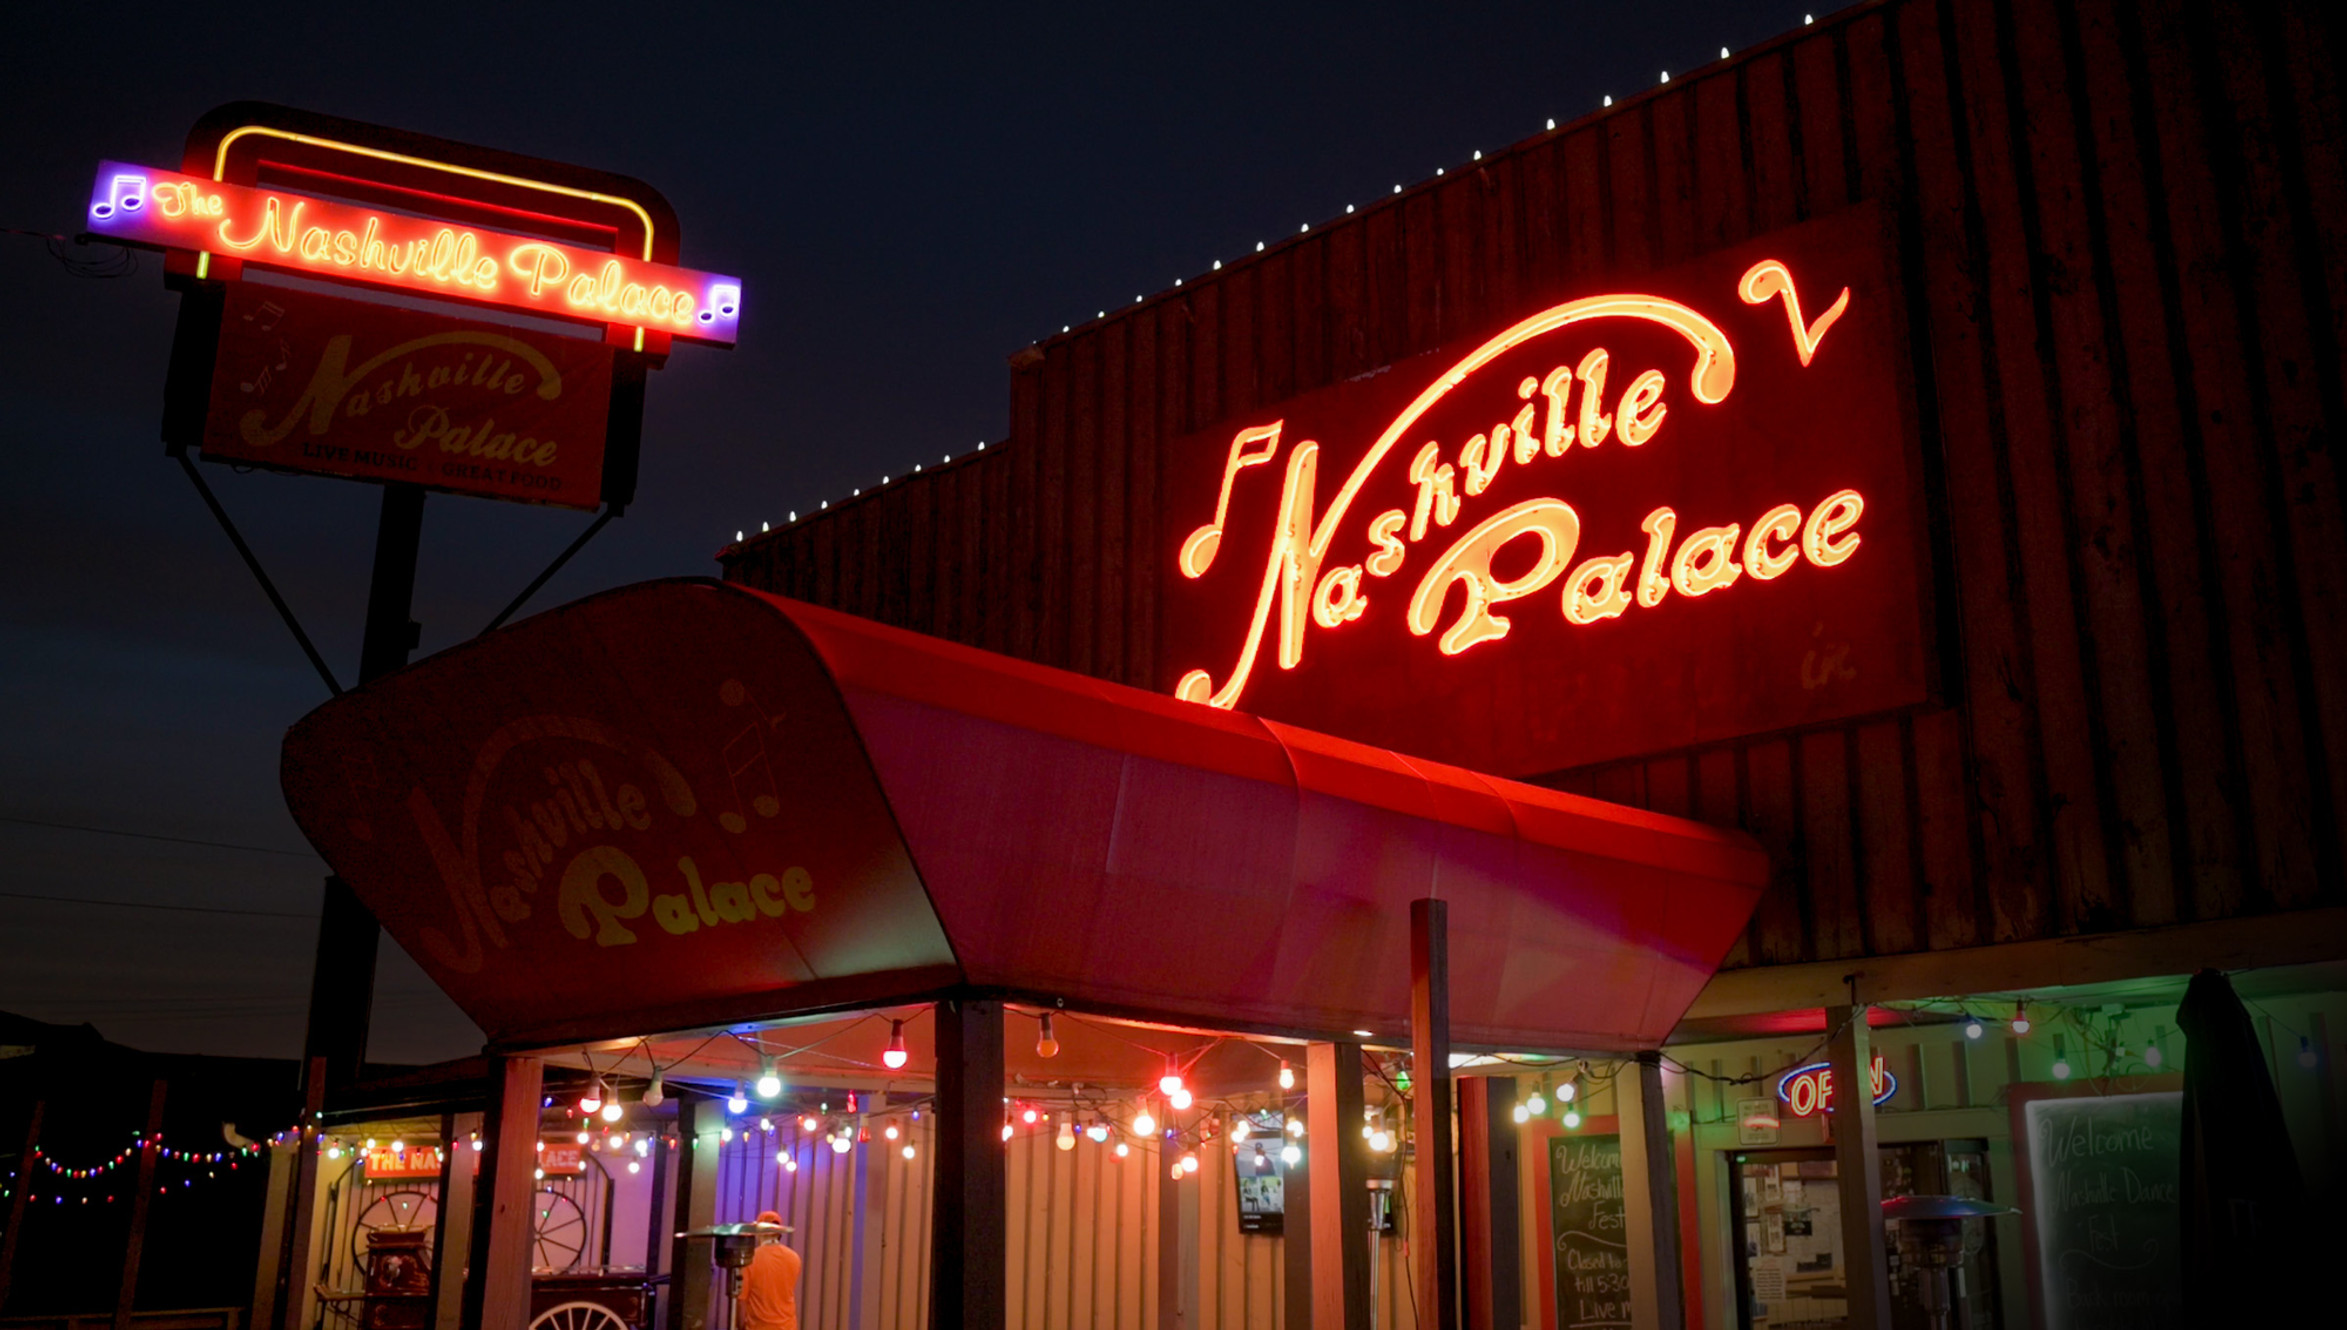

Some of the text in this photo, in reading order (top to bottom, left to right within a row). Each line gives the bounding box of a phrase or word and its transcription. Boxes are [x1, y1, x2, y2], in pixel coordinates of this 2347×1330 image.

[152, 180, 695, 327] The Nashville Palace
[238, 329, 563, 448] Nashville
[393, 404, 560, 468] Palace
[302, 442, 563, 491] LIVE MUSIC GREAT FOOD
[1175, 293, 1735, 711] Nashville
[1406, 489, 1864, 656] Palace
[407, 713, 698, 974] Nashville
[557, 844, 816, 948] Palace
[369, 1151, 406, 1171] THE
[1555, 1143, 1622, 1175] Welcom
[2039, 1116, 2155, 1168] Welcome
[1560, 1170, 1625, 1208] Nashvill
[2120, 1165, 2178, 1205] Dance
[1588, 1199, 1627, 1230] Fest
[1567, 1248, 1606, 1271] Closed
[1579, 1298, 1617, 1321] Live
